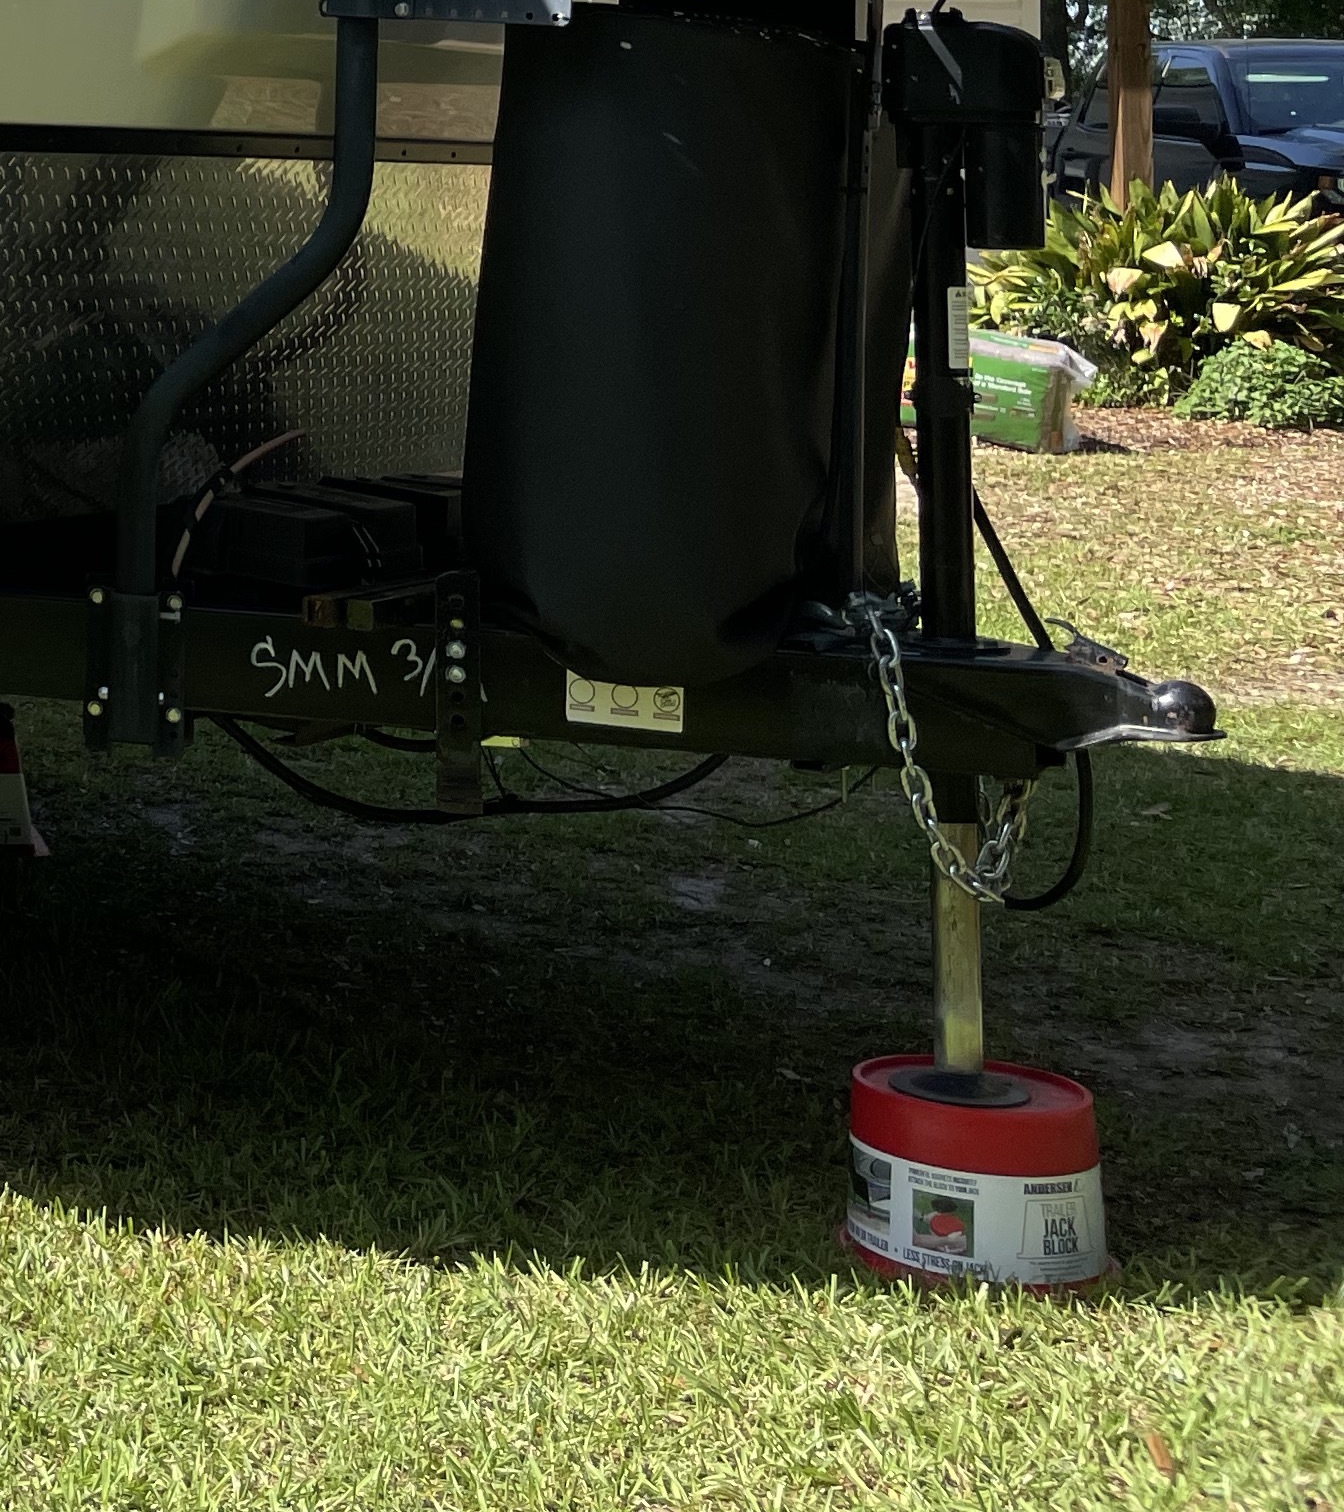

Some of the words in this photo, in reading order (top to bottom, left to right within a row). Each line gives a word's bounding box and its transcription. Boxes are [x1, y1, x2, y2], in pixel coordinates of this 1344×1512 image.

[1023, 1181, 1073, 1196] ANDERSEN
[1040, 1201, 1077, 1218] TRAILER
[1043, 1216, 1078, 1239] JACK
[902, 1246, 920, 1262] LESS
[1043, 1236, 1079, 1256] BLOCK
